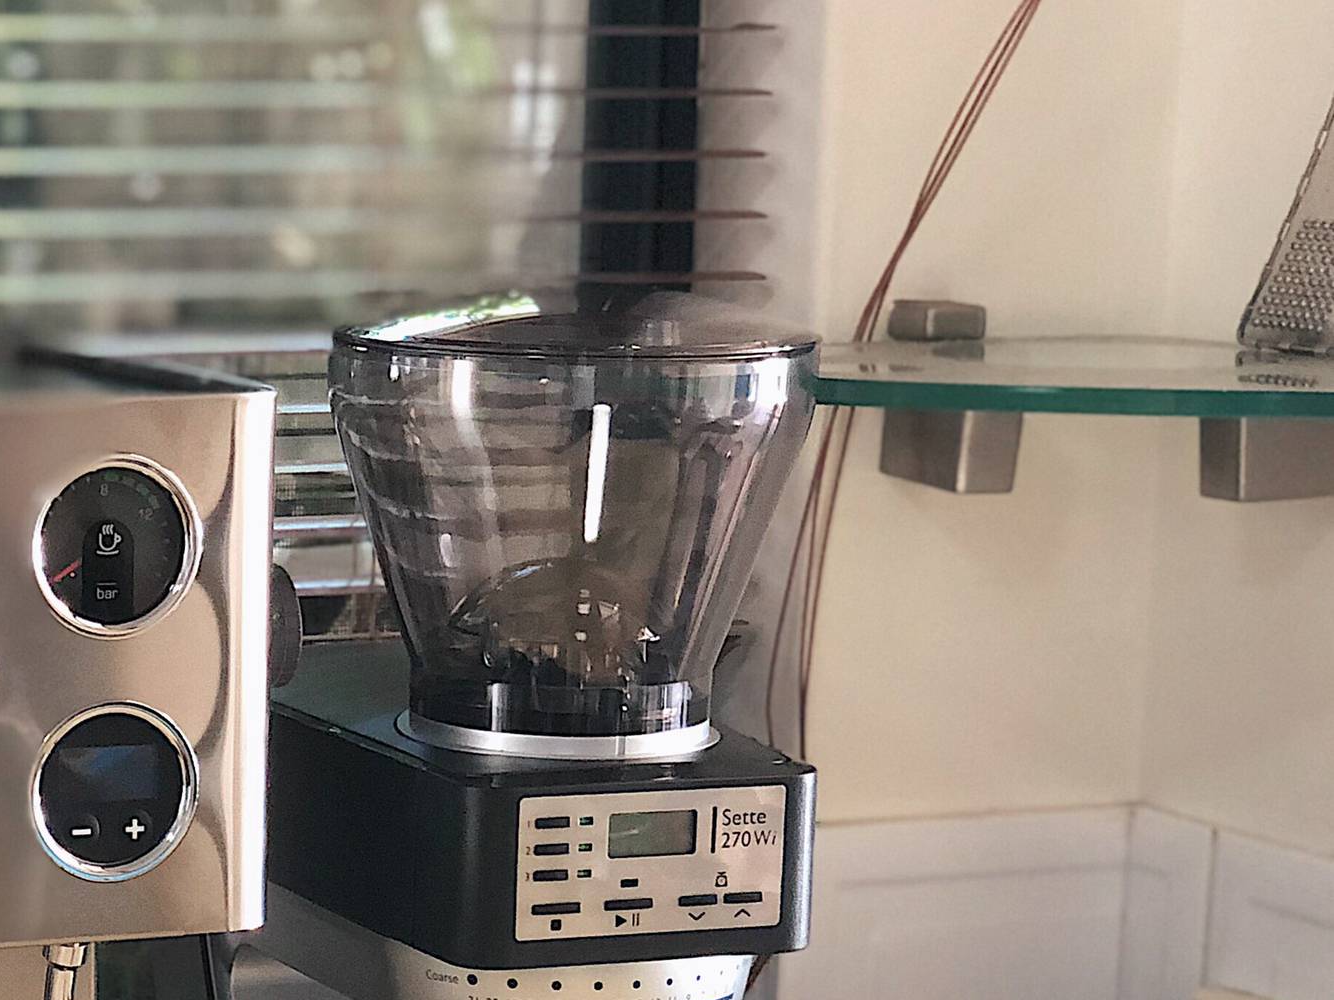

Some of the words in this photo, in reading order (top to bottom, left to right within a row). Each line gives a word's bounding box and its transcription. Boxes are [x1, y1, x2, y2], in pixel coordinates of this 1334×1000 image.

[96, 587, 119, 600] bar
[721, 808, 767, 827] Sette
[525, 846, 532, 856] 2
[524, 872, 531, 882] 3
[425, 968, 460, 985] Coarse
